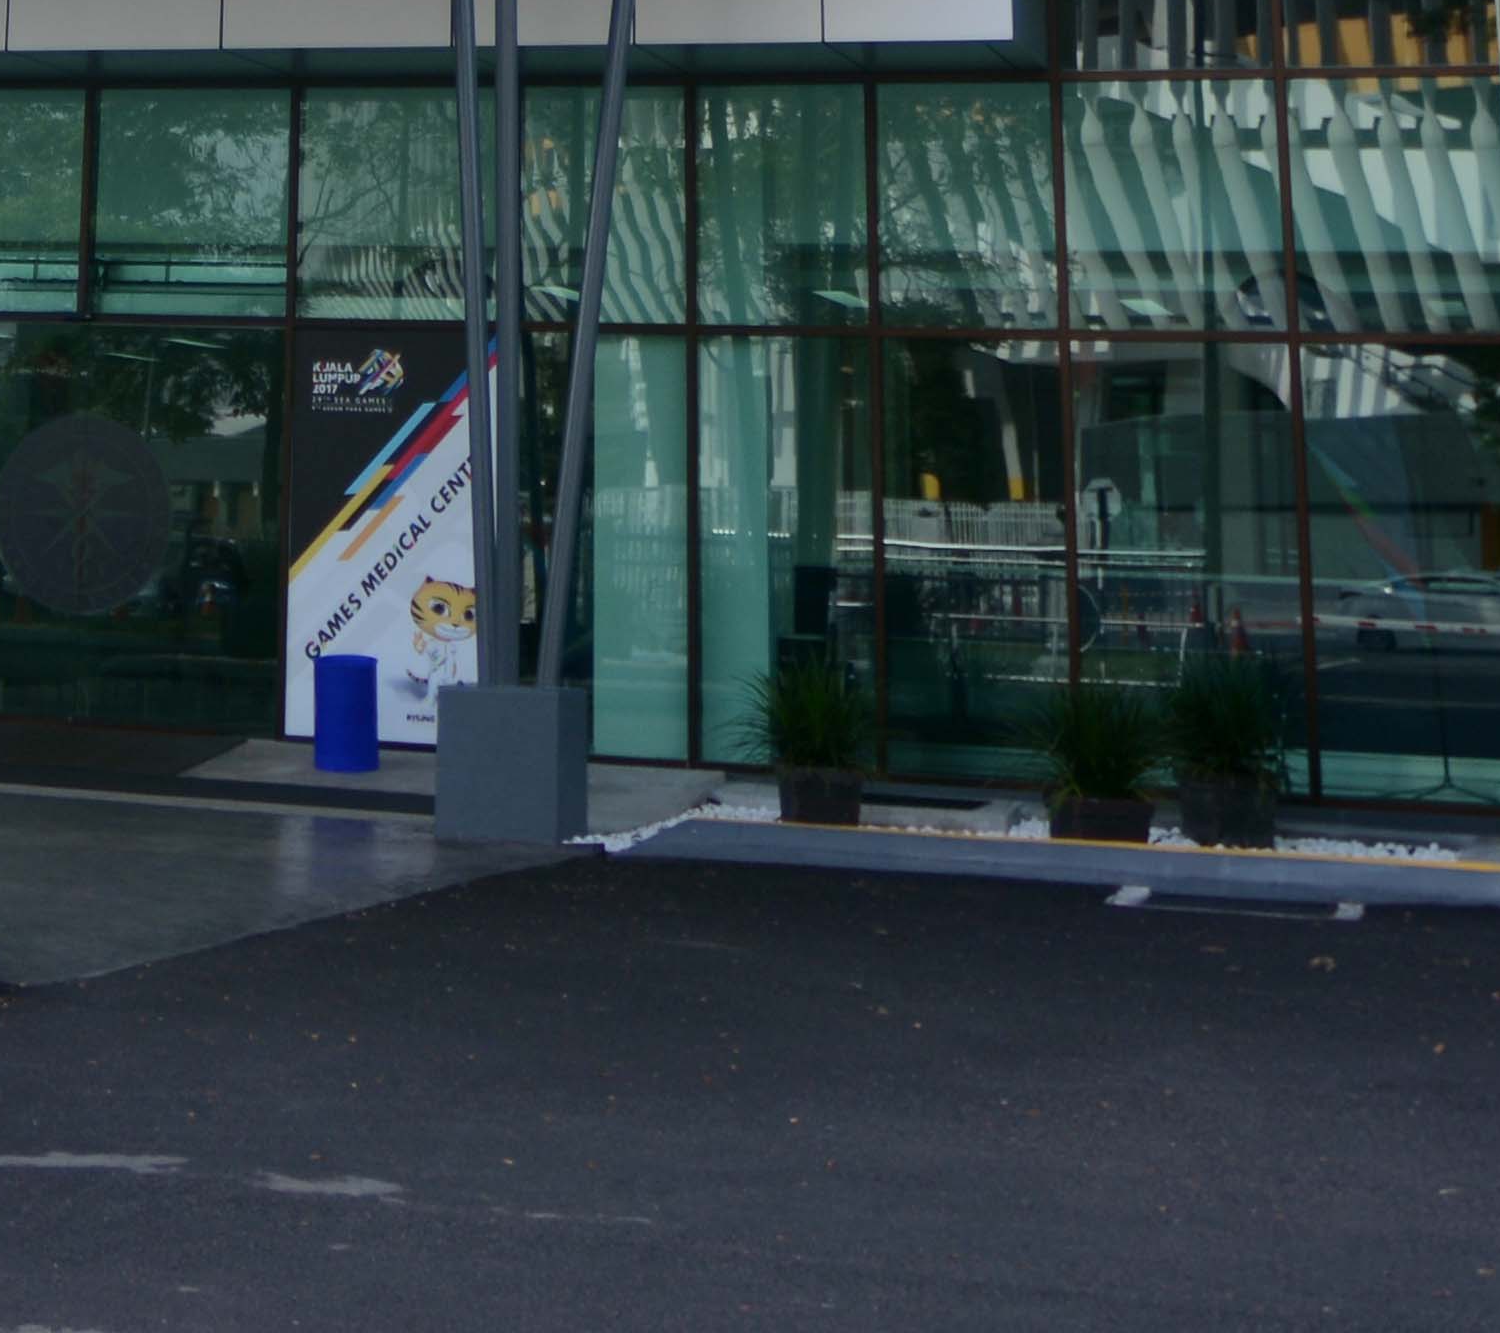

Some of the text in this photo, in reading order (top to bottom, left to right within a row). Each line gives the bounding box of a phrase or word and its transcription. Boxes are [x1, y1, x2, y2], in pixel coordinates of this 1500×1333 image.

[312, 384, 338, 394] 2017
[304, 593, 362, 661] GAMES
[360, 514, 432, 598] MEDICAL
